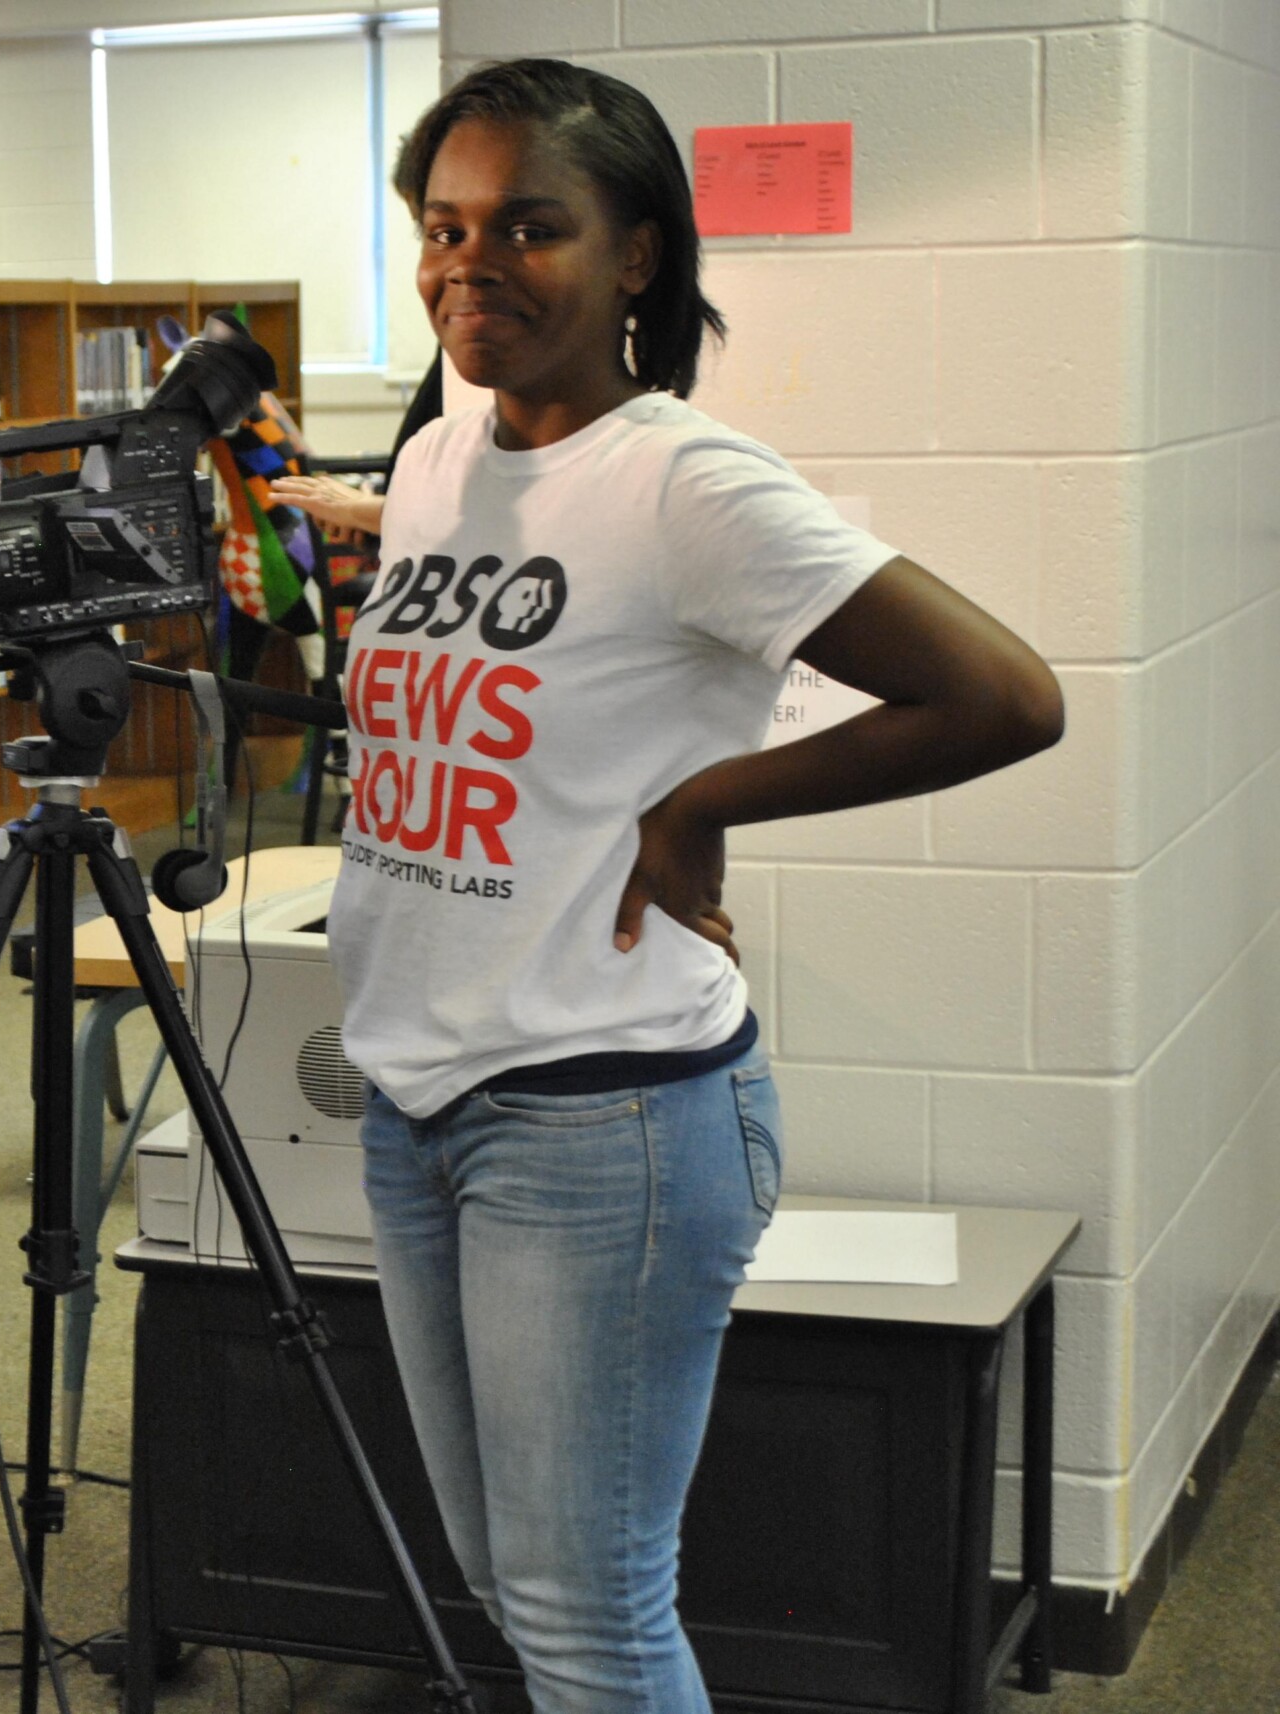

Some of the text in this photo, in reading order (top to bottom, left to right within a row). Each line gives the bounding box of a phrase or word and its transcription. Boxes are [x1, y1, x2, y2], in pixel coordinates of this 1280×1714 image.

[357, 554, 504, 639] PBS
[786, 670, 825, 689] THE
[772, 704, 806, 724] ER!
[376, 853, 443, 891] PORTING
[450, 873, 515, 900] LABS
